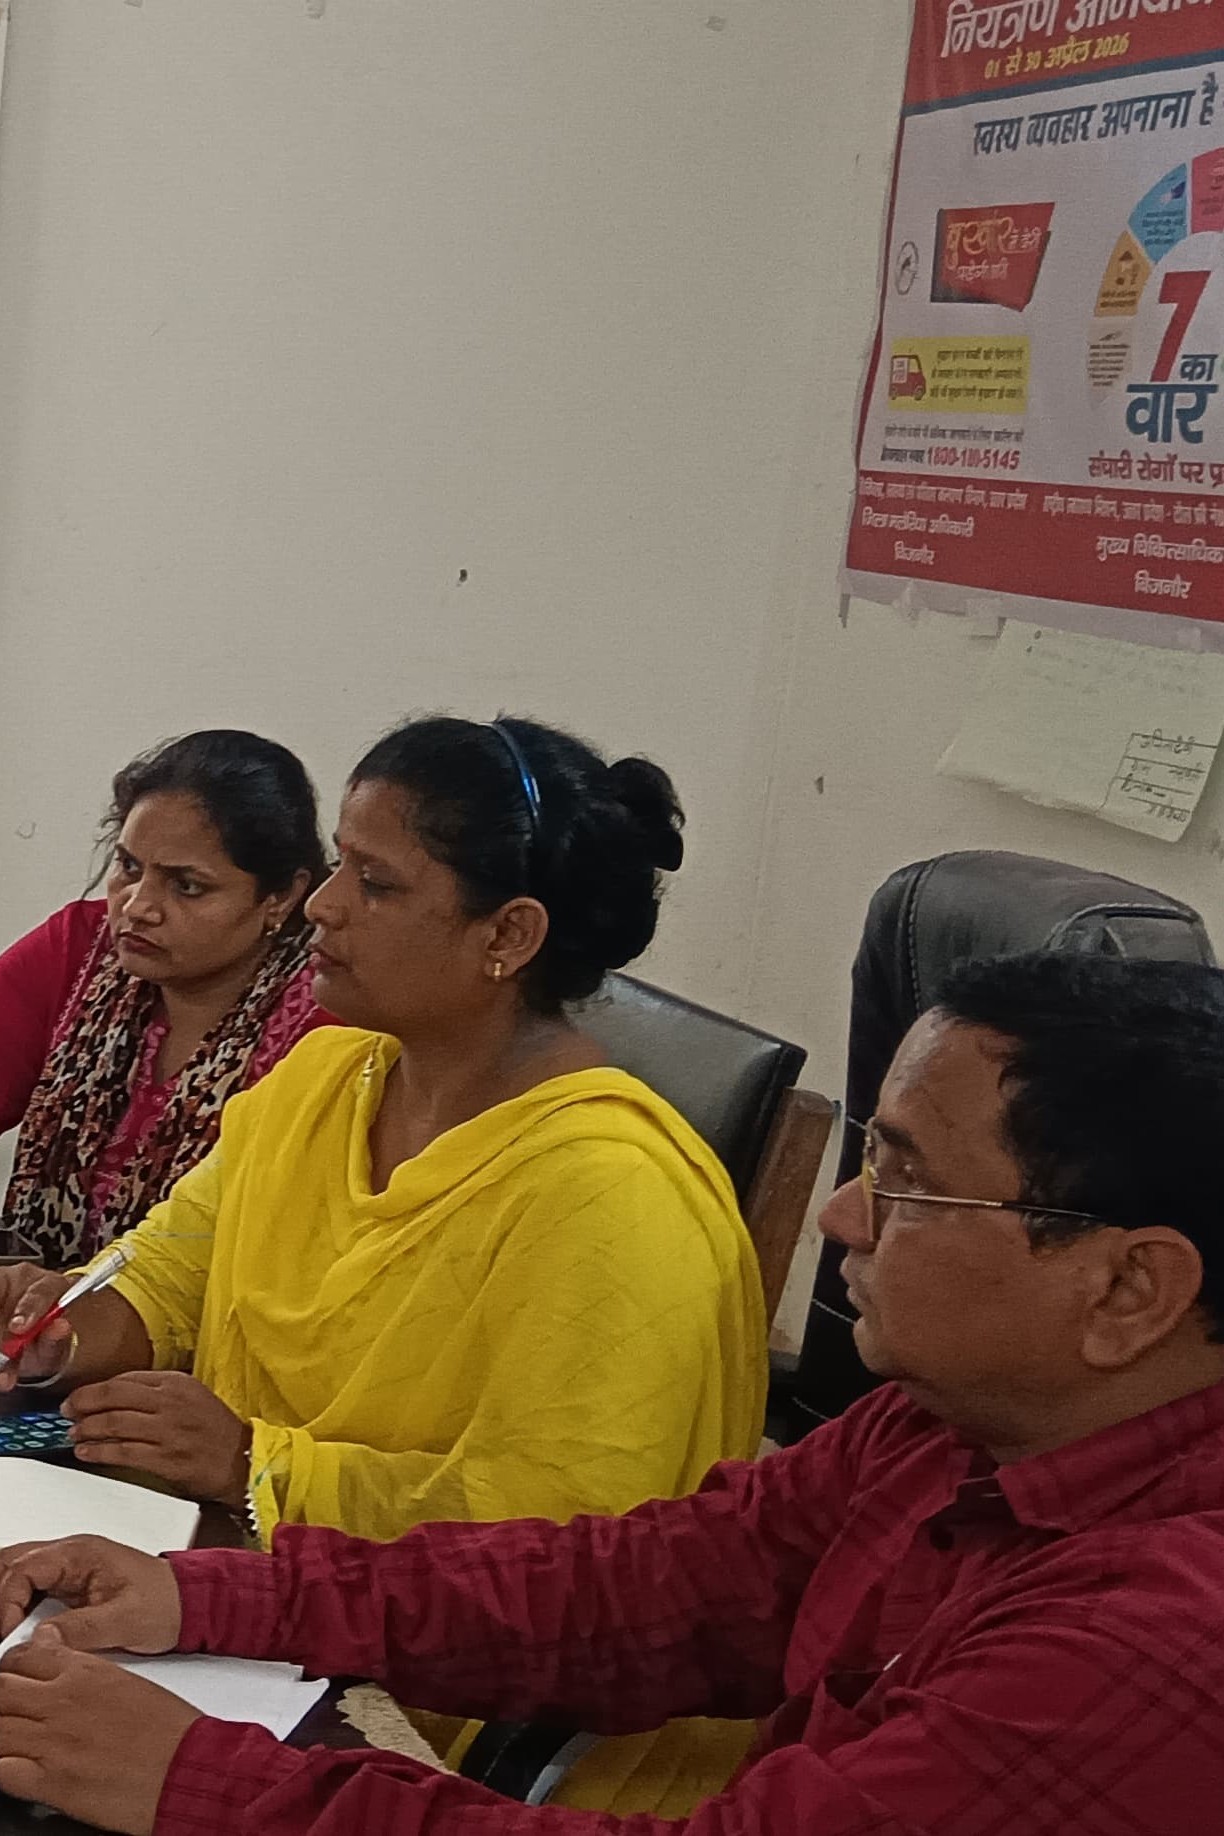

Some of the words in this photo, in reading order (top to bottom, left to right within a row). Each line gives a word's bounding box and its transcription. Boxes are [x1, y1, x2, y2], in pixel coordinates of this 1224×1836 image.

[1005, 48, 1023, 76] से
[1024, 51, 1042, 72] 30
[1093, 32, 1130, 59] 2026
[1026, 104, 1097, 147] व्यवहार
[1097, 90, 1196, 138] अपनाना
[1199, 71, 1219, 126] है
[1150, 270, 1211, 382] 7
[1180, 354, 1218, 382] का
[1126, 383, 1219, 445] वार
[1179, 461, 1205, 484] पर
[1096, 535, 1130, 562] मुख्य
